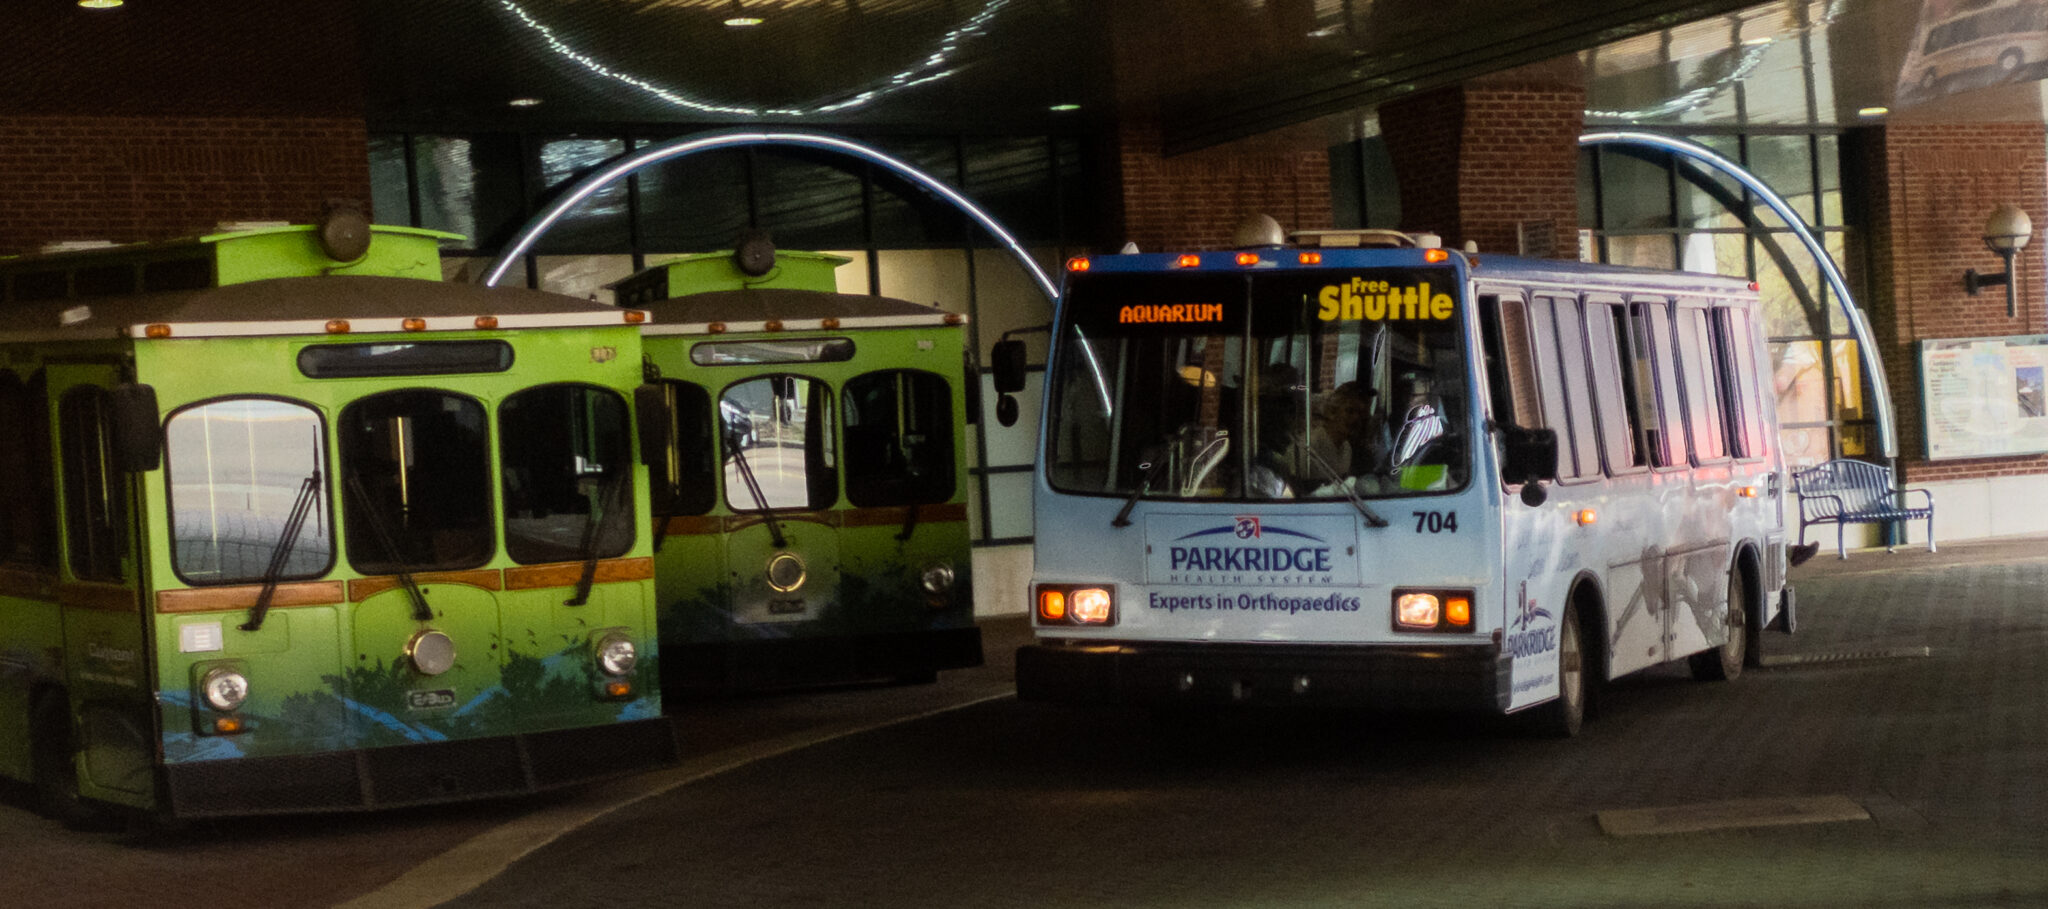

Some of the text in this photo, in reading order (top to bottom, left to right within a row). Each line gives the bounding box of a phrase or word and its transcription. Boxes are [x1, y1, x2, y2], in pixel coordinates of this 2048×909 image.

[1351, 276, 1389, 294] Free
[1318, 282, 1454, 321] Shuttle
[1119, 303, 1223, 324] AQUARIUM
[1412, 511, 1458, 534] 704
[1170, 546, 1333, 572] PARKRIDGE
[1170, 574, 1333, 585] HEALTH SYSTEM
[1149, 592, 1361, 615] Experts in Orthopaedics
